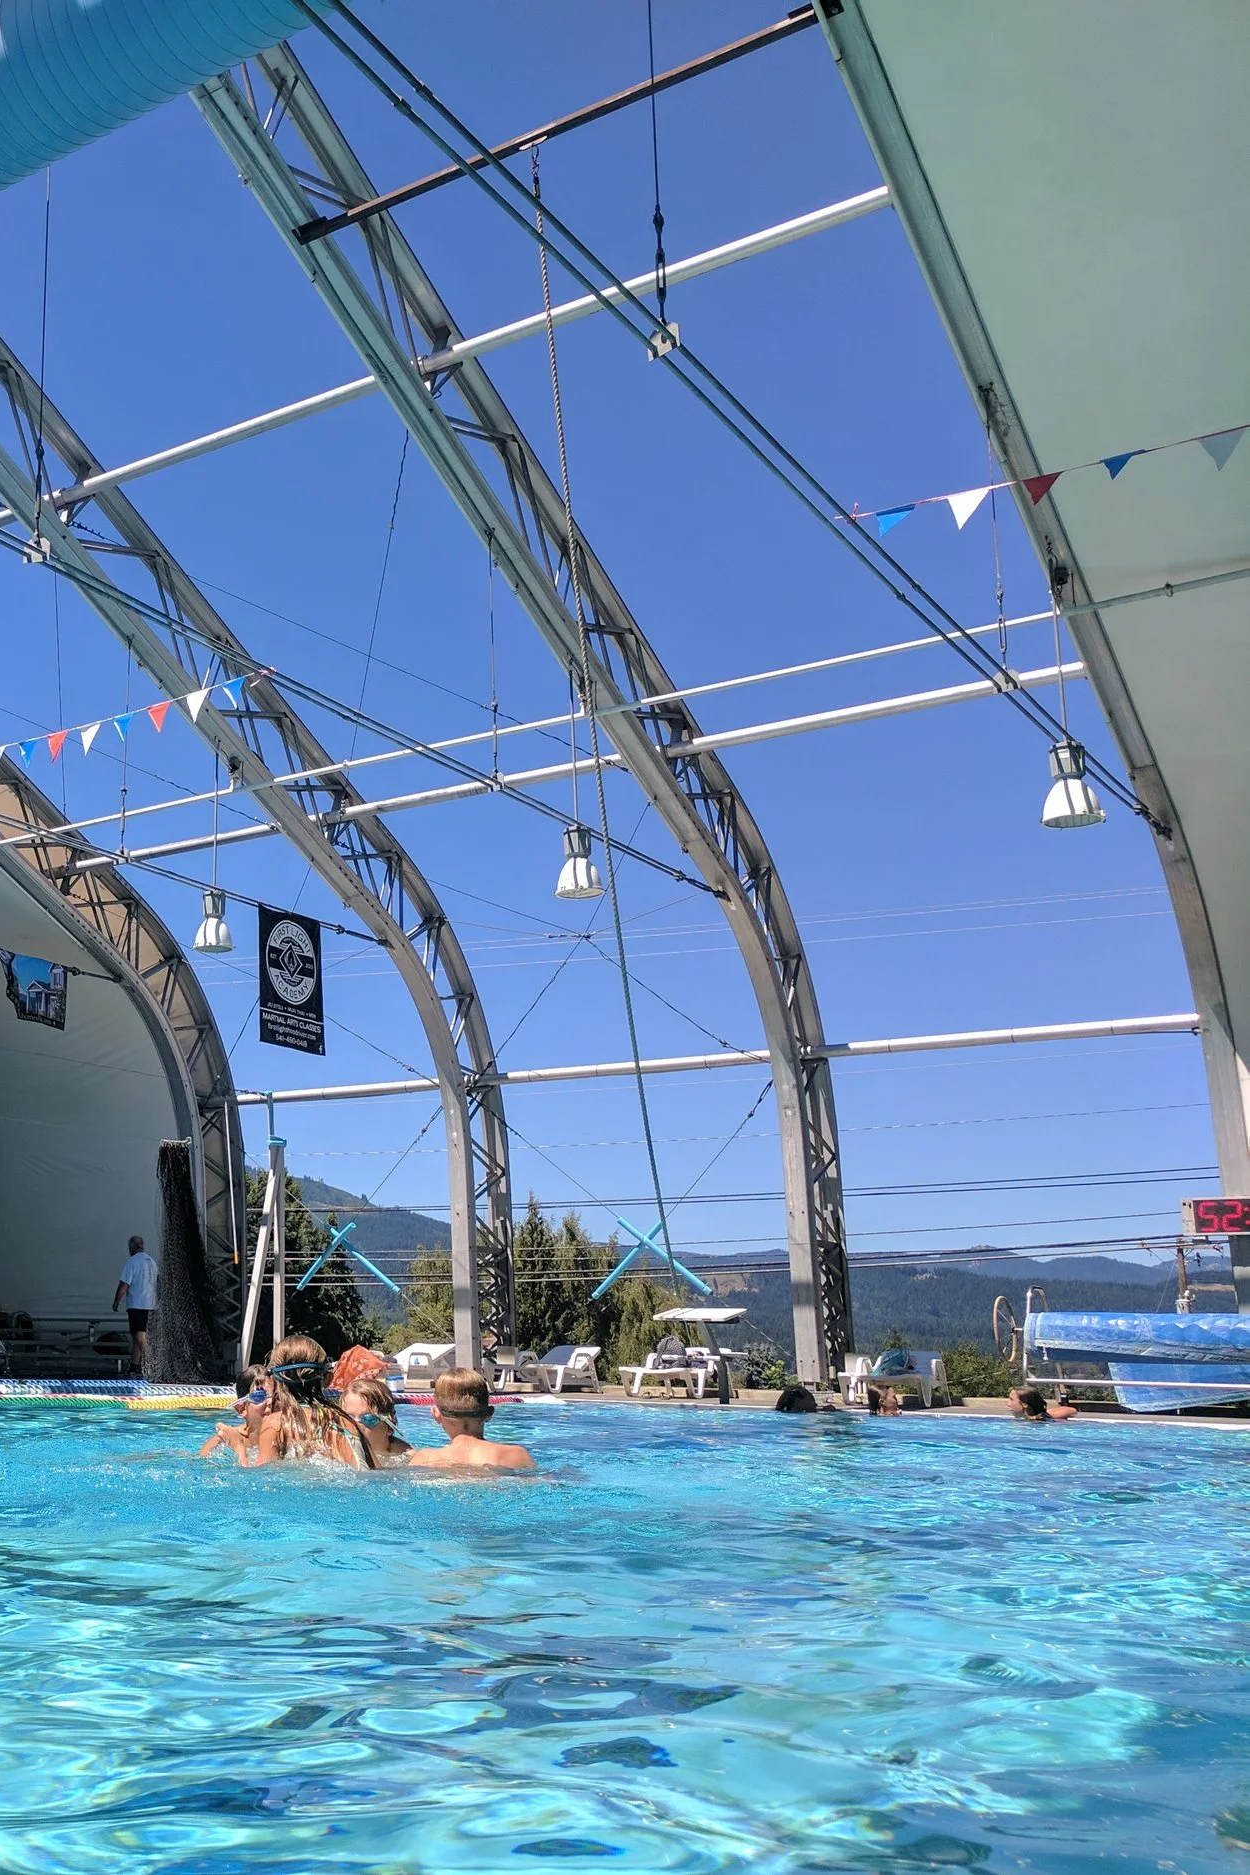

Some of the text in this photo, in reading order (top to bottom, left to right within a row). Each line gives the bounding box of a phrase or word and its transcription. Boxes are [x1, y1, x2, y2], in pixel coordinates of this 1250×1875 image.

[273, 926, 311, 953] FIRST LIGHT
[274, 974, 309, 999] ACADEMY
[262, 1011, 321, 1034] MARTIAL ARTS CLASSES
